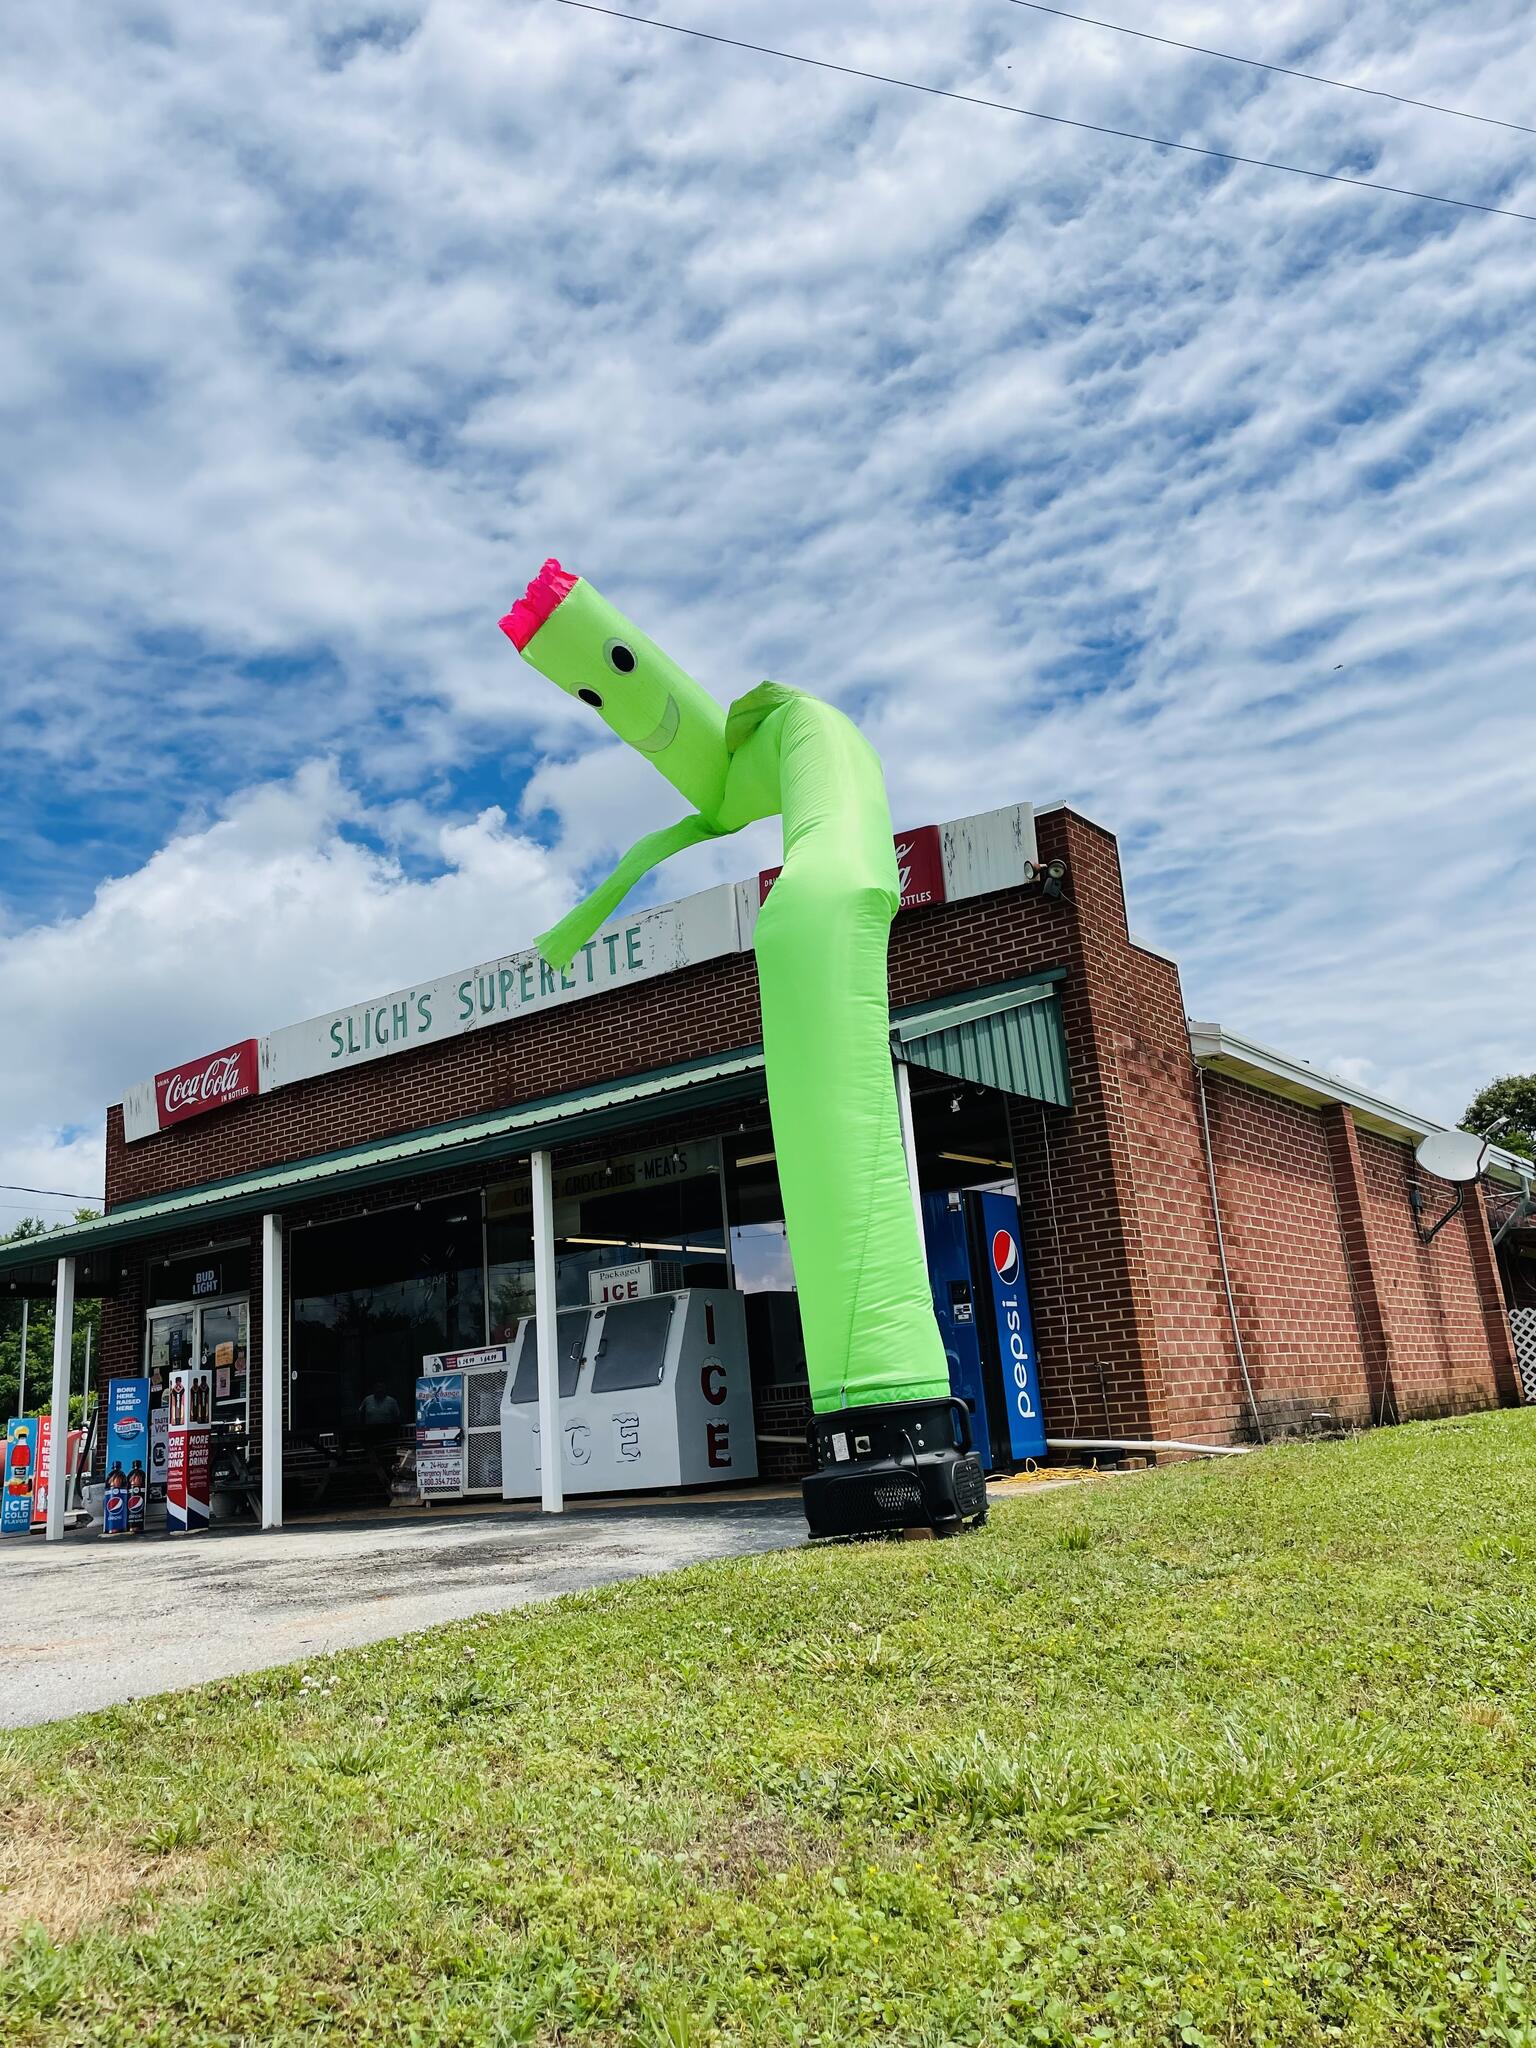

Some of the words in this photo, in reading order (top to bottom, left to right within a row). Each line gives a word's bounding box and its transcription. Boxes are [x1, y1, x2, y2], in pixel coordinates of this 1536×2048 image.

[900, 891, 932, 907] OTTLES
[330, 991, 433, 1058] SLIGH'S
[165, 1051, 241, 1112] Coca-Cola
[221, 1094, 228, 1103] IN
[228, 1086, 249, 1100] BOTTLES
[195, 1270, 215, 1283] BUD
[600, 1266, 640, 1280] Packaged
[192, 1279, 218, 1296] LIGHT
[600, 1280, 639, 1304] ICE
[1002, 1300, 1036, 1418] pepsi
[701, 1298, 732, 1469] ICE
[169, 1436, 185, 1446] ORE
[189, 1435, 209, 1445] MORE
[168, 1450, 184, 1459] ORTS
[189, 1449, 209, 1457] SPORTS
[168, 1459, 184, 1468] RINK
[188, 1457, 209, 1466] DRINK
[430, 1461, 449, 1469] 24-Hour
[418, 1469, 441, 1478] Emergency
[442, 1469, 461, 1477] Number
[4, 1500, 30, 1512] ICE
[4, 1511, 29, 1519] COLD
